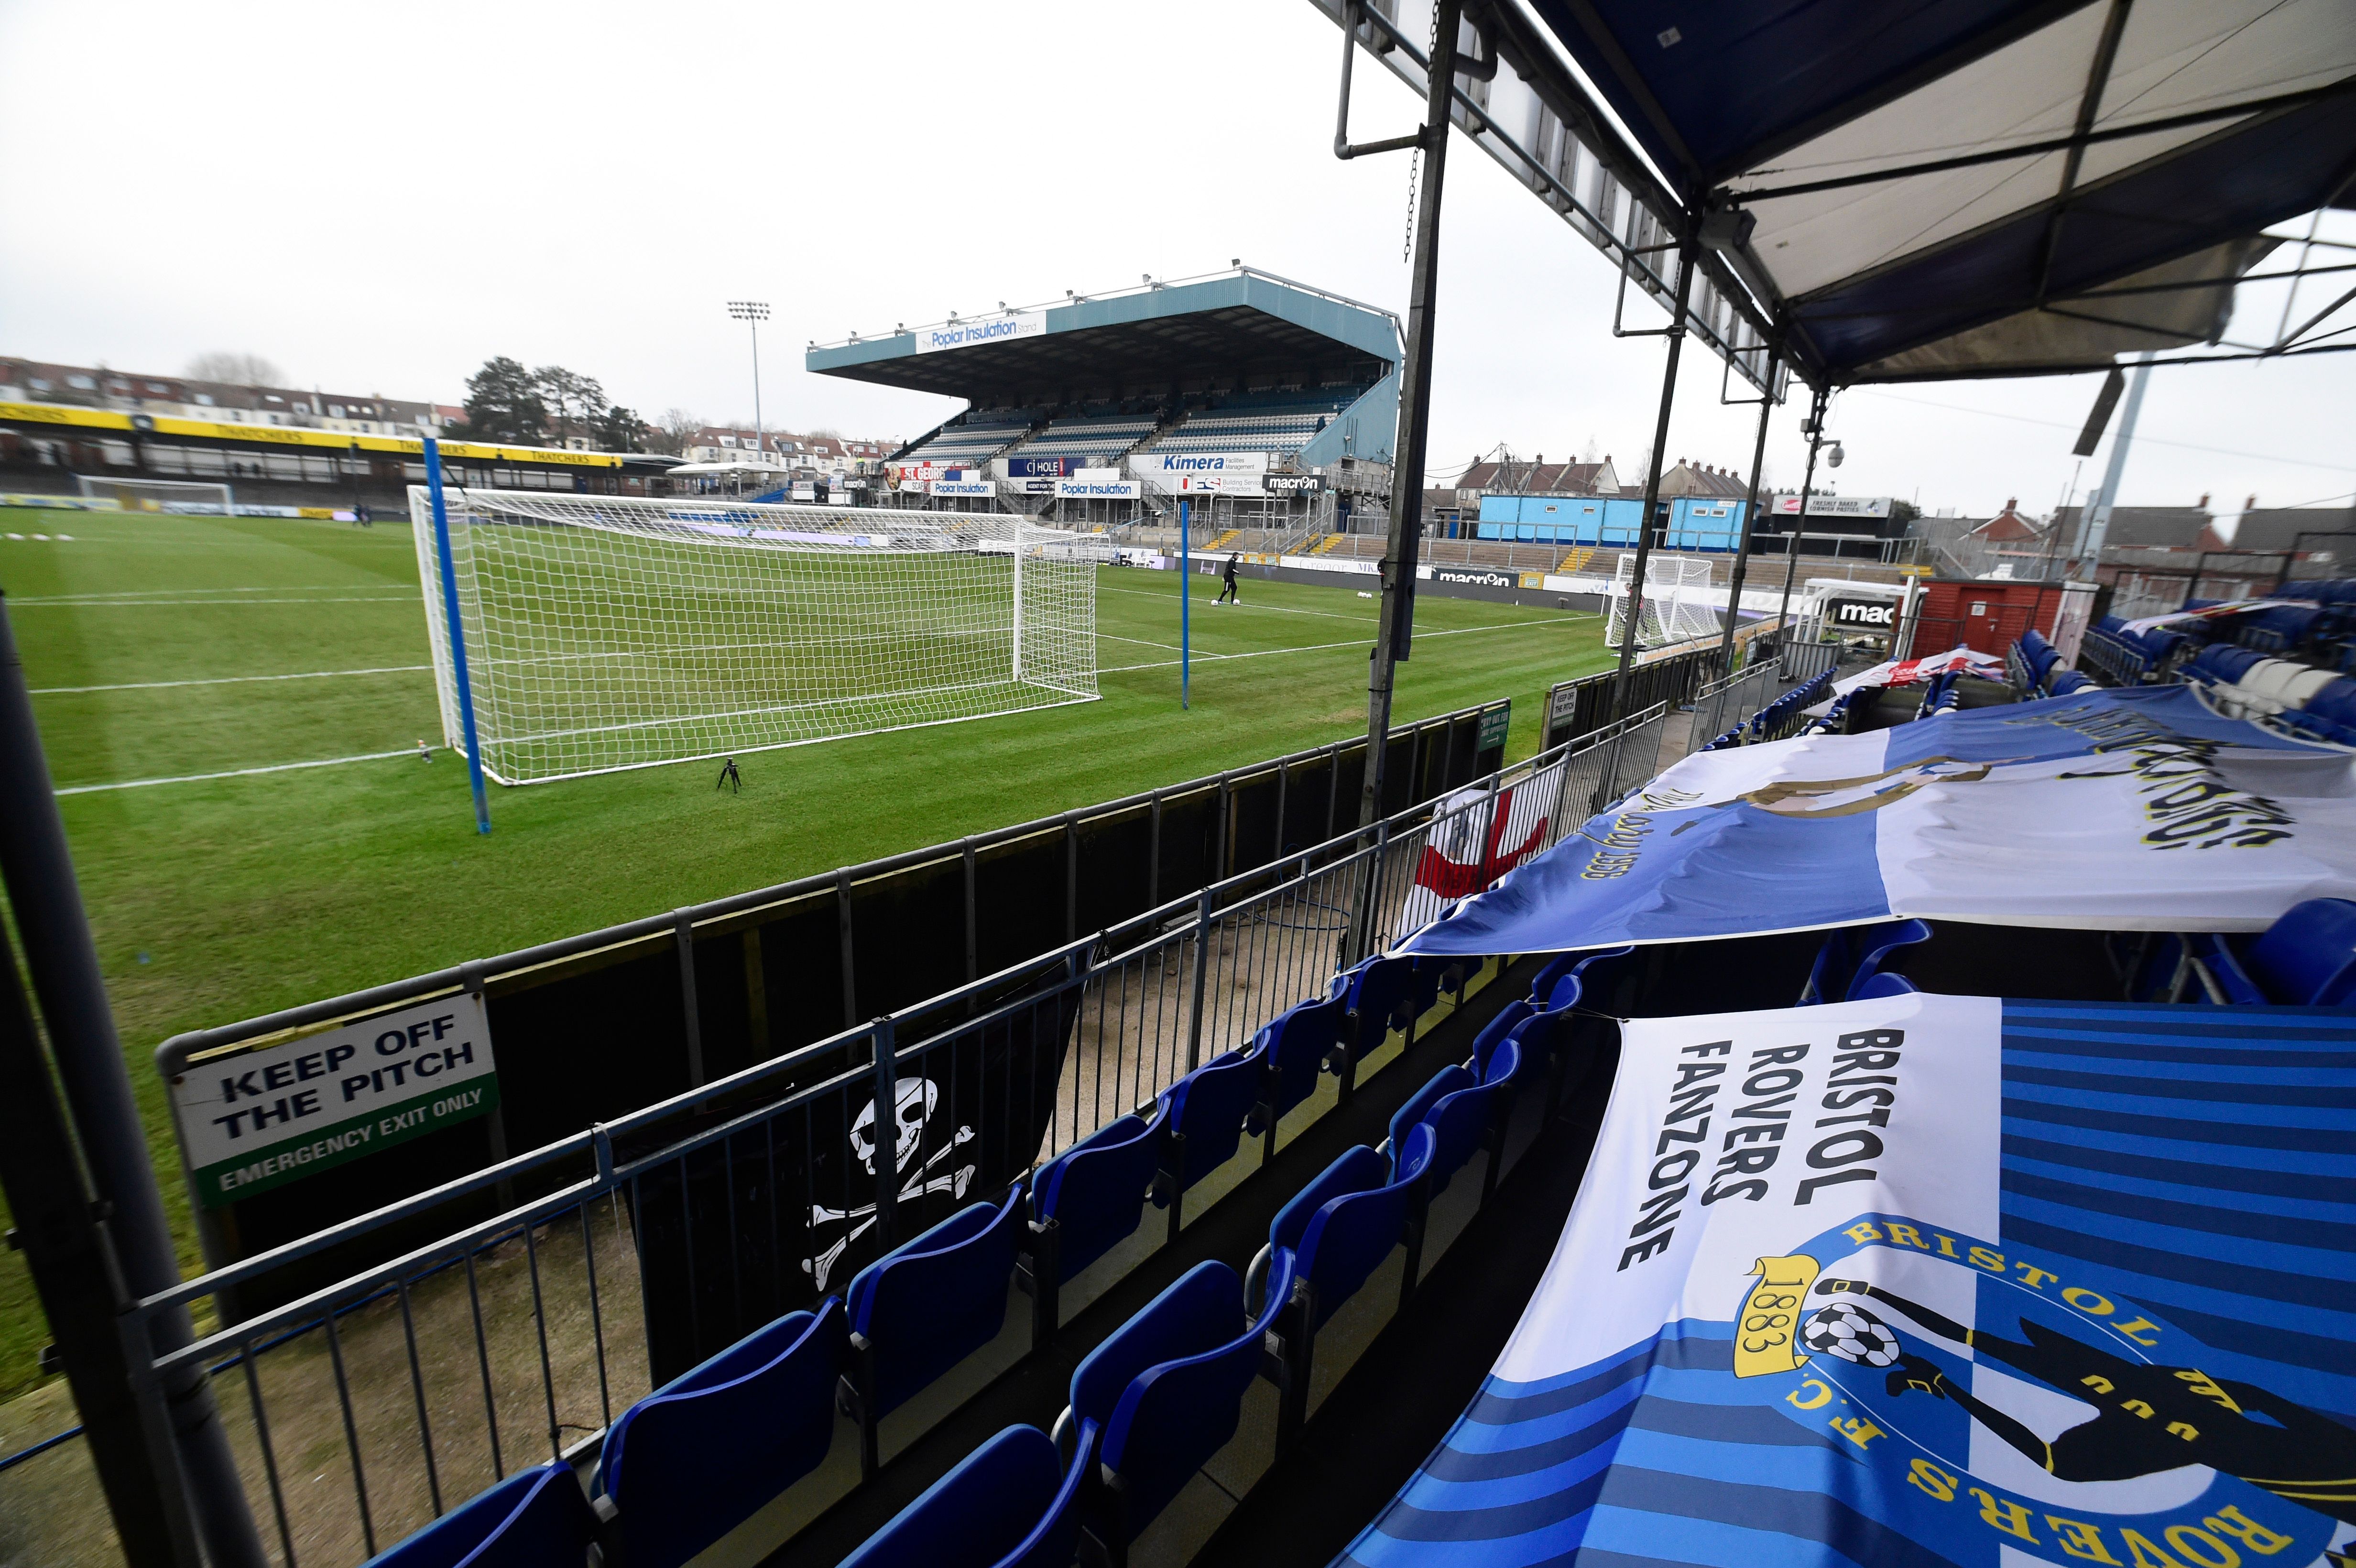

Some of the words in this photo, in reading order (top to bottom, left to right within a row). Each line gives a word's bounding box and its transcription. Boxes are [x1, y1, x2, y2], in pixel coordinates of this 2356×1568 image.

[922, 340, 931, 348] The
[932, 329, 964, 348] Poplar
[966, 320, 1017, 341] Insulation
[1018, 323, 1036, 334] Stand
[531, 451, 589, 464] THATCHERS
[1037, 462, 1058, 472] HOLE
[1163, 455, 1224, 470] Kimera
[844, 479, 866, 490] macron
[905, 468, 916, 480] ST.
[1269, 476, 1318, 489] macron
[935, 483, 955, 494] Poplar
[957, 483, 988, 493] Insulation
[1061, 482, 1088, 496] Poplar
[1090, 483, 1132, 495] Insulation
[1439, 573, 1510, 588] macron
[1557, 694, 1567, 703] KEEP
[1563, 701, 1574, 711] PITCH
[1580, 851, 1642, 880] 1956
[220, 1044, 356, 1104] KEEP
[374, 1014, 455, 1056] OFF
[212, 1089, 323, 1140] THE
[341, 1041, 475, 1103] PITCH
[1700, 1043, 1811, 1207] ROVERS
[1793, 1028, 1905, 1206] BRISTOL
[218, 1124, 373, 1193] EMERGENCY
[380, 1106, 427, 1137] EXIT
[433, 1088, 483, 1118] ONLY
[1616, 1039, 1733, 1273] FANZONE
[1842, 1220, 2163, 1351] BRISTOL
[1742, 1276, 1798, 1353] 1883
[1785, 1371, 1889, 1451] F.C.
[1906, 1456, 2294, 1568] ROVERS
